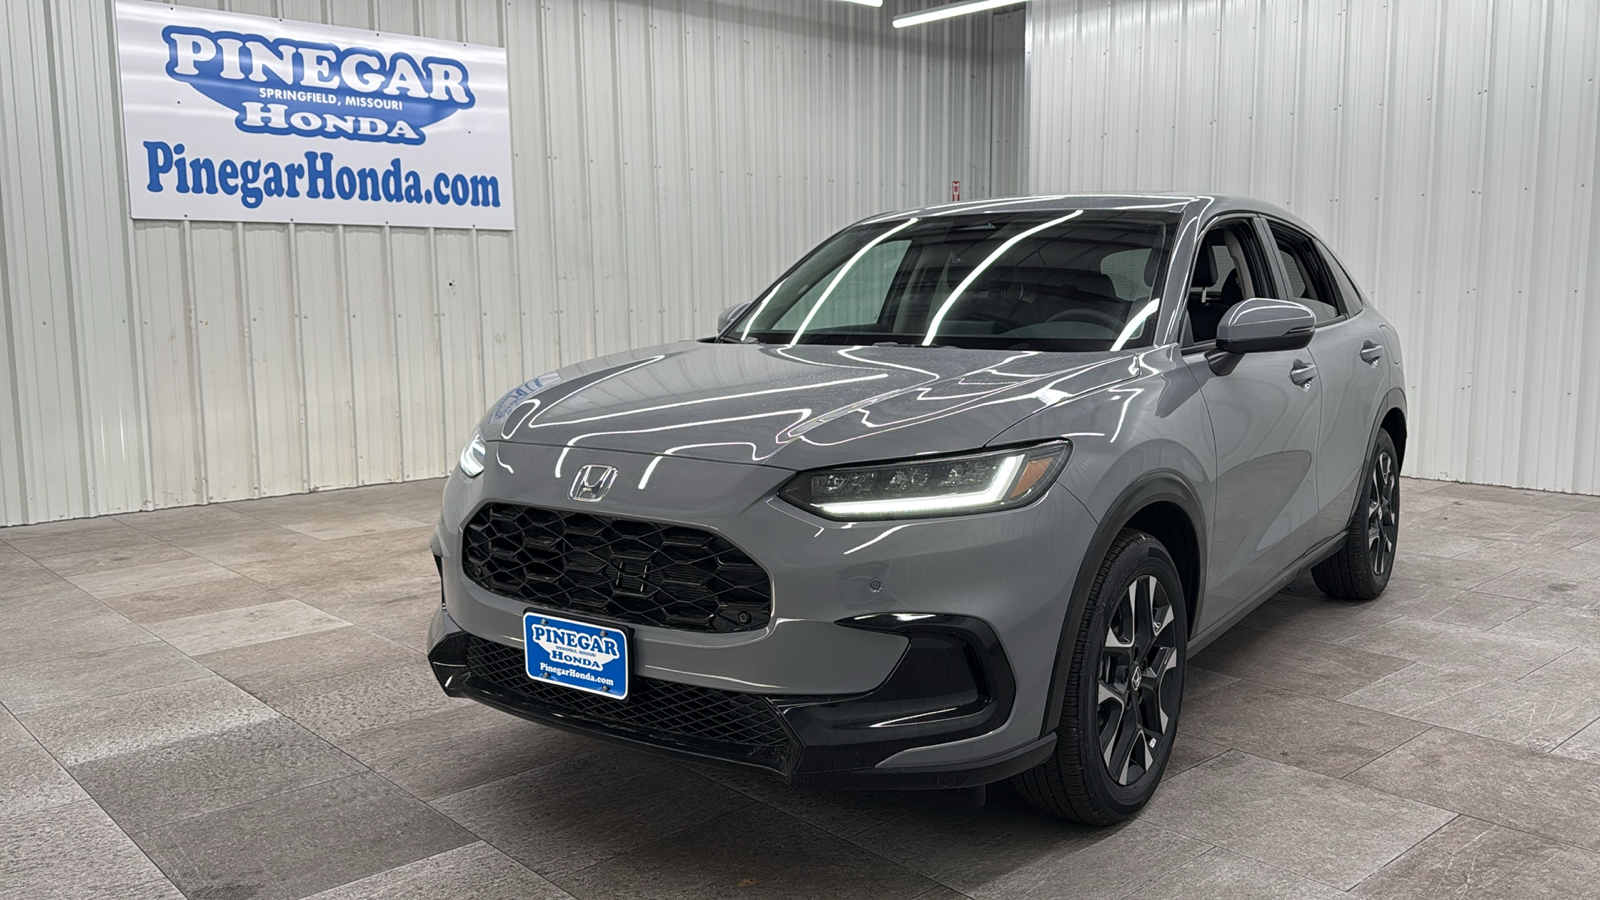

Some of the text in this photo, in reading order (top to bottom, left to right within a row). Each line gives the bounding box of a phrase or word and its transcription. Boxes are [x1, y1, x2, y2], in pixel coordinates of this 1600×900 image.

[168, 32, 471, 104] PINEGAR
[259, 87, 403, 110] SPRINGFIELD, MISSOURI
[241, 101, 421, 139] HONDA
[143, 140, 501, 209] PinegarHonda.com
[533, 626, 618, 657] PINEGAR
[540, 661, 614, 686] PinegarHonda.com
[551, 649, 602, 668] HONDA
